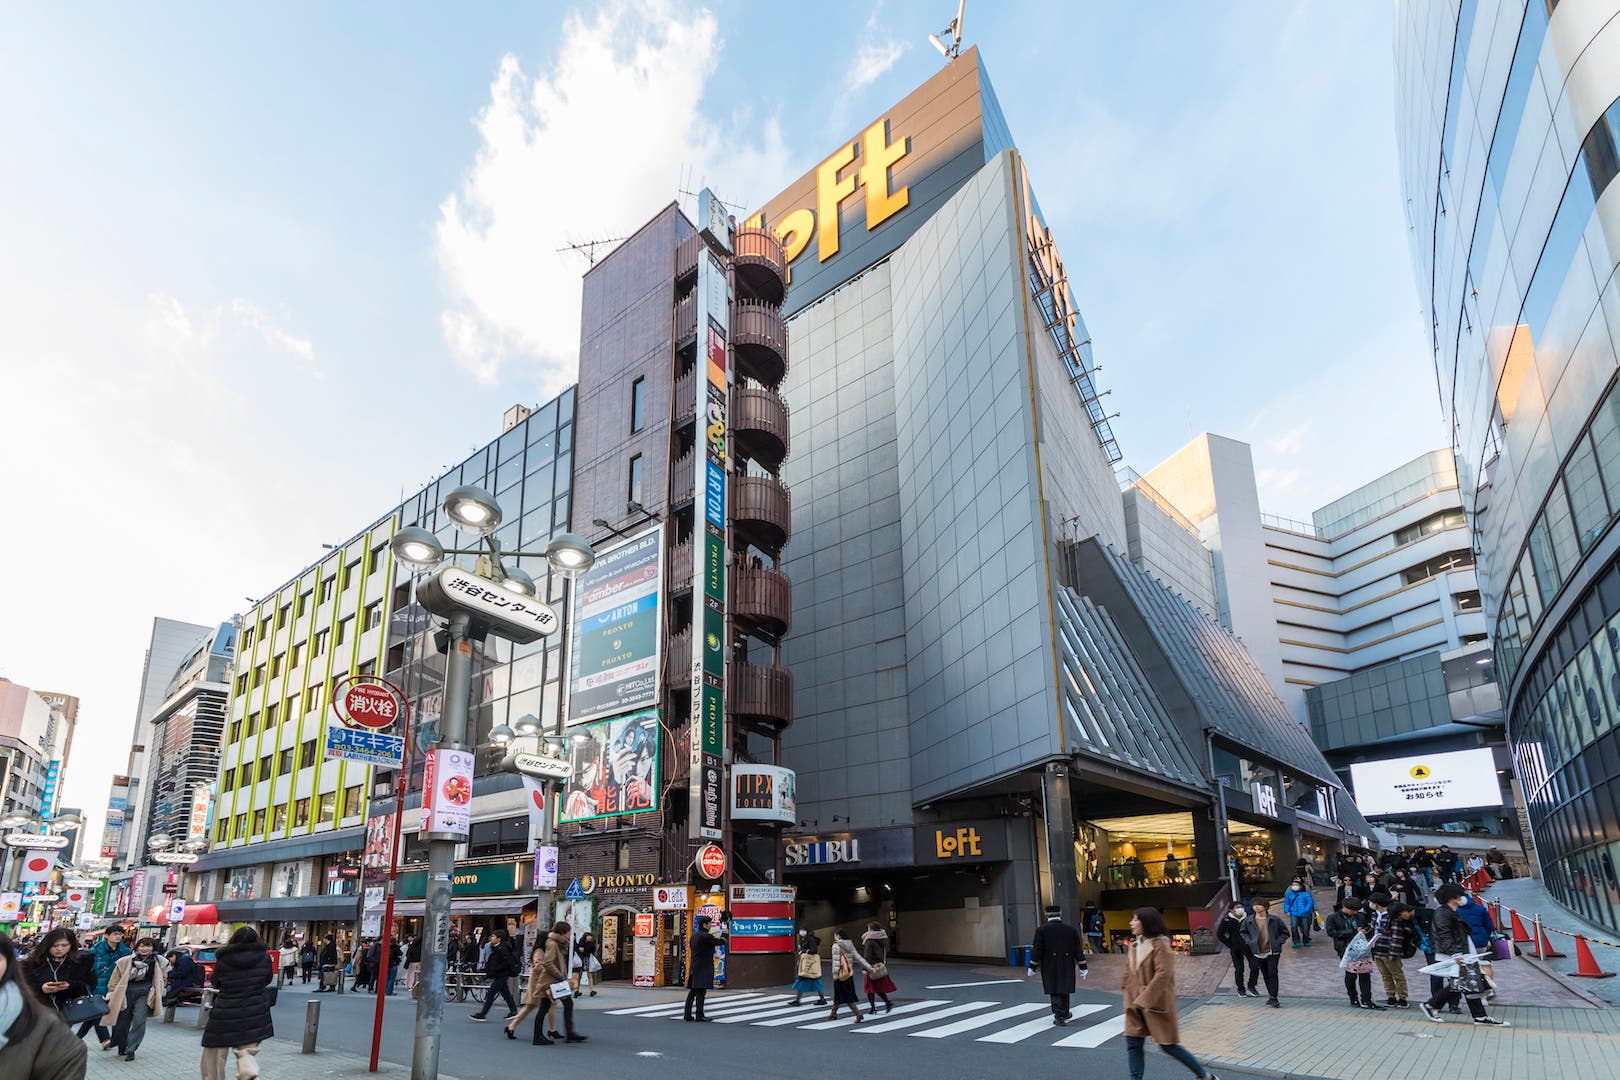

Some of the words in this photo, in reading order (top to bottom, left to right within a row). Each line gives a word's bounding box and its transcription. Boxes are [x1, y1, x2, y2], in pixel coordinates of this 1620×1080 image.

[709, 467, 721, 523] ARTON
[449, 577, 553, 625] 渋谷センター街
[611, 602, 638, 622] ARTON
[602, 622, 633, 637] PRONTO
[601, 651, 632, 667] PRONTO
[349, 694, 394, 717] 消火栓
[347, 731, 402, 752] セキネ
[518, 758, 570, 772] 渋谷センター街
[737, 798, 772, 808] TOKYO
[1405, 790, 1444, 800] お知らせ
[598, 873, 655, 888] PRONTO
